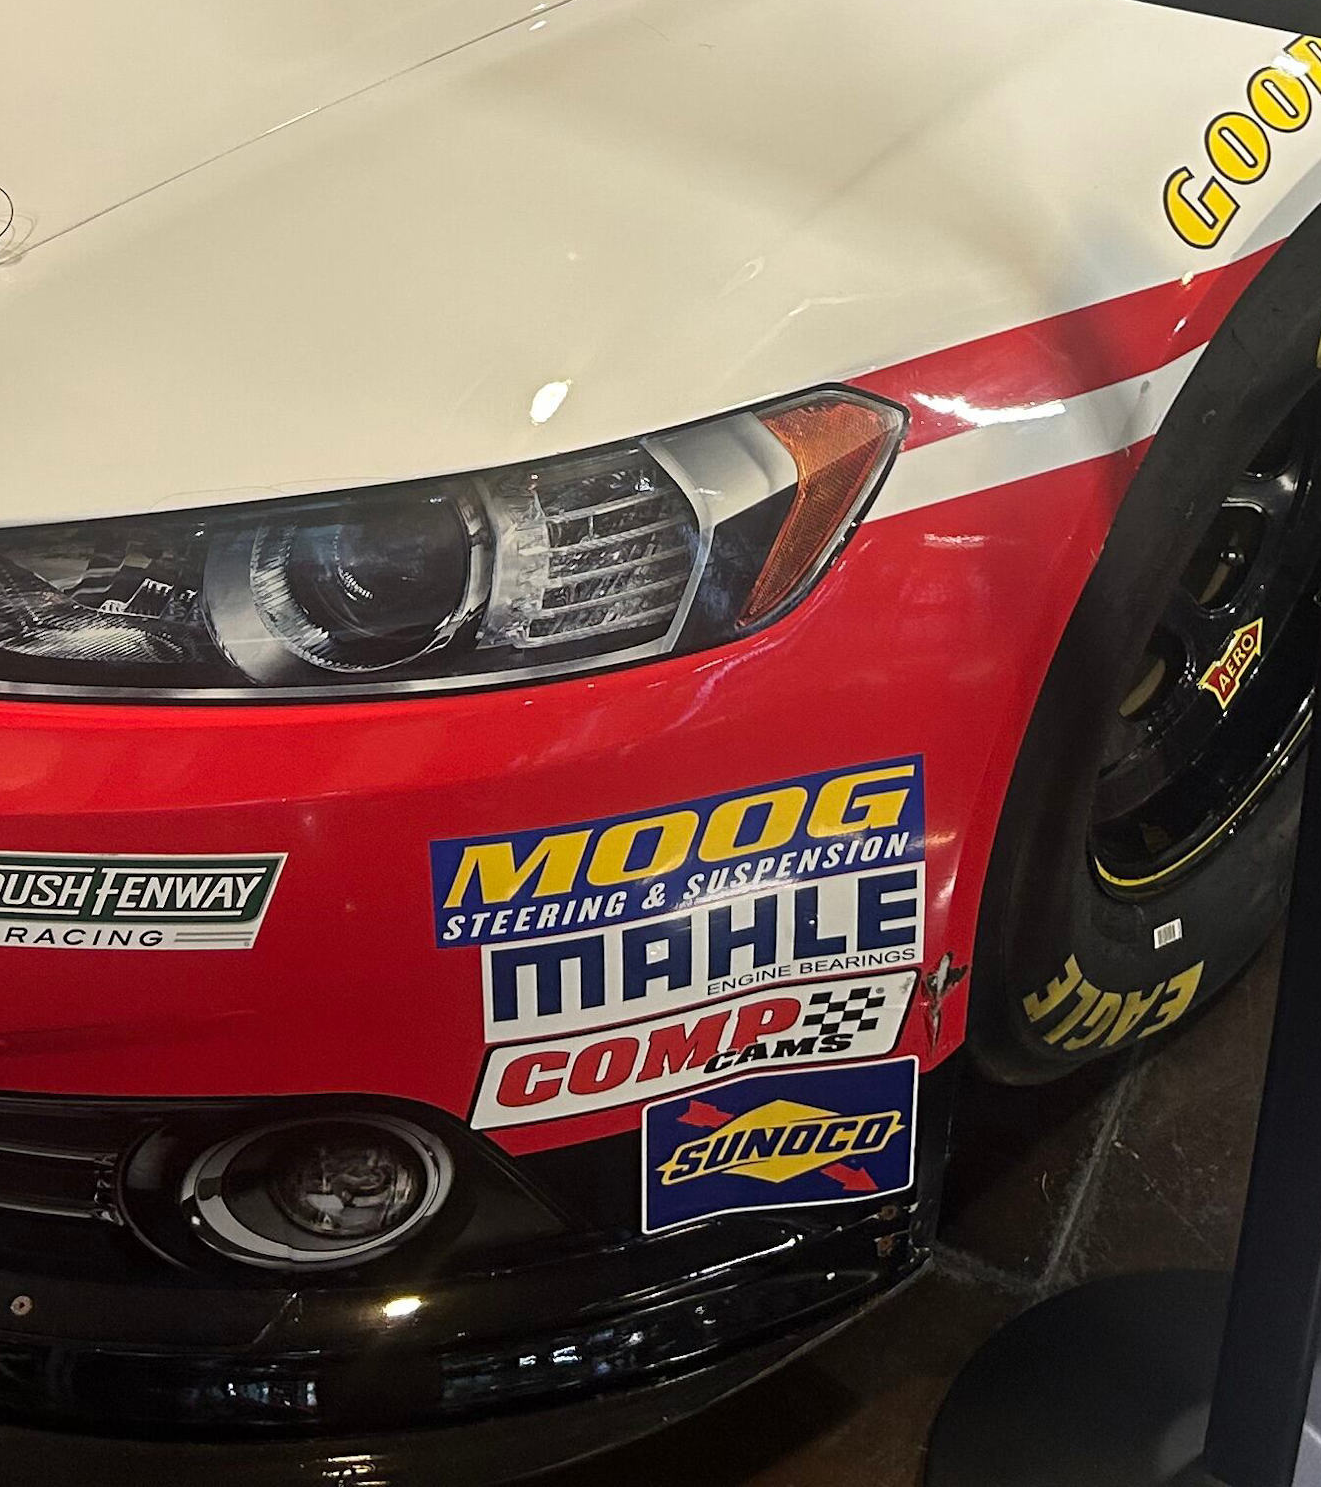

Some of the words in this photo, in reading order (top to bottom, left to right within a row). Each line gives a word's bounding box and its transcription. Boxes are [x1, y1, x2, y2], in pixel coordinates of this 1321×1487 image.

[1219, 634, 1255, 693] AERO
[443, 764, 916, 909] MOOG
[90, 866, 264, 917] FENWAY
[443, 889, 629, 942] STEERING
[641, 882, 667, 911] &
[682, 831, 911, 902] SUSPENSION
[4, 926, 165, 947] RACING
[491, 869, 918, 1023] MAHLE
[707, 964, 792, 996] ENGINE
[799, 947, 917, 974] BEARINGS
[1022, 953, 1204, 1051] EAGLE
[496, 997, 802, 1108] COMP
[703, 1033, 854, 1075] CAMS
[676, 1115, 894, 1177] SUNOCO
